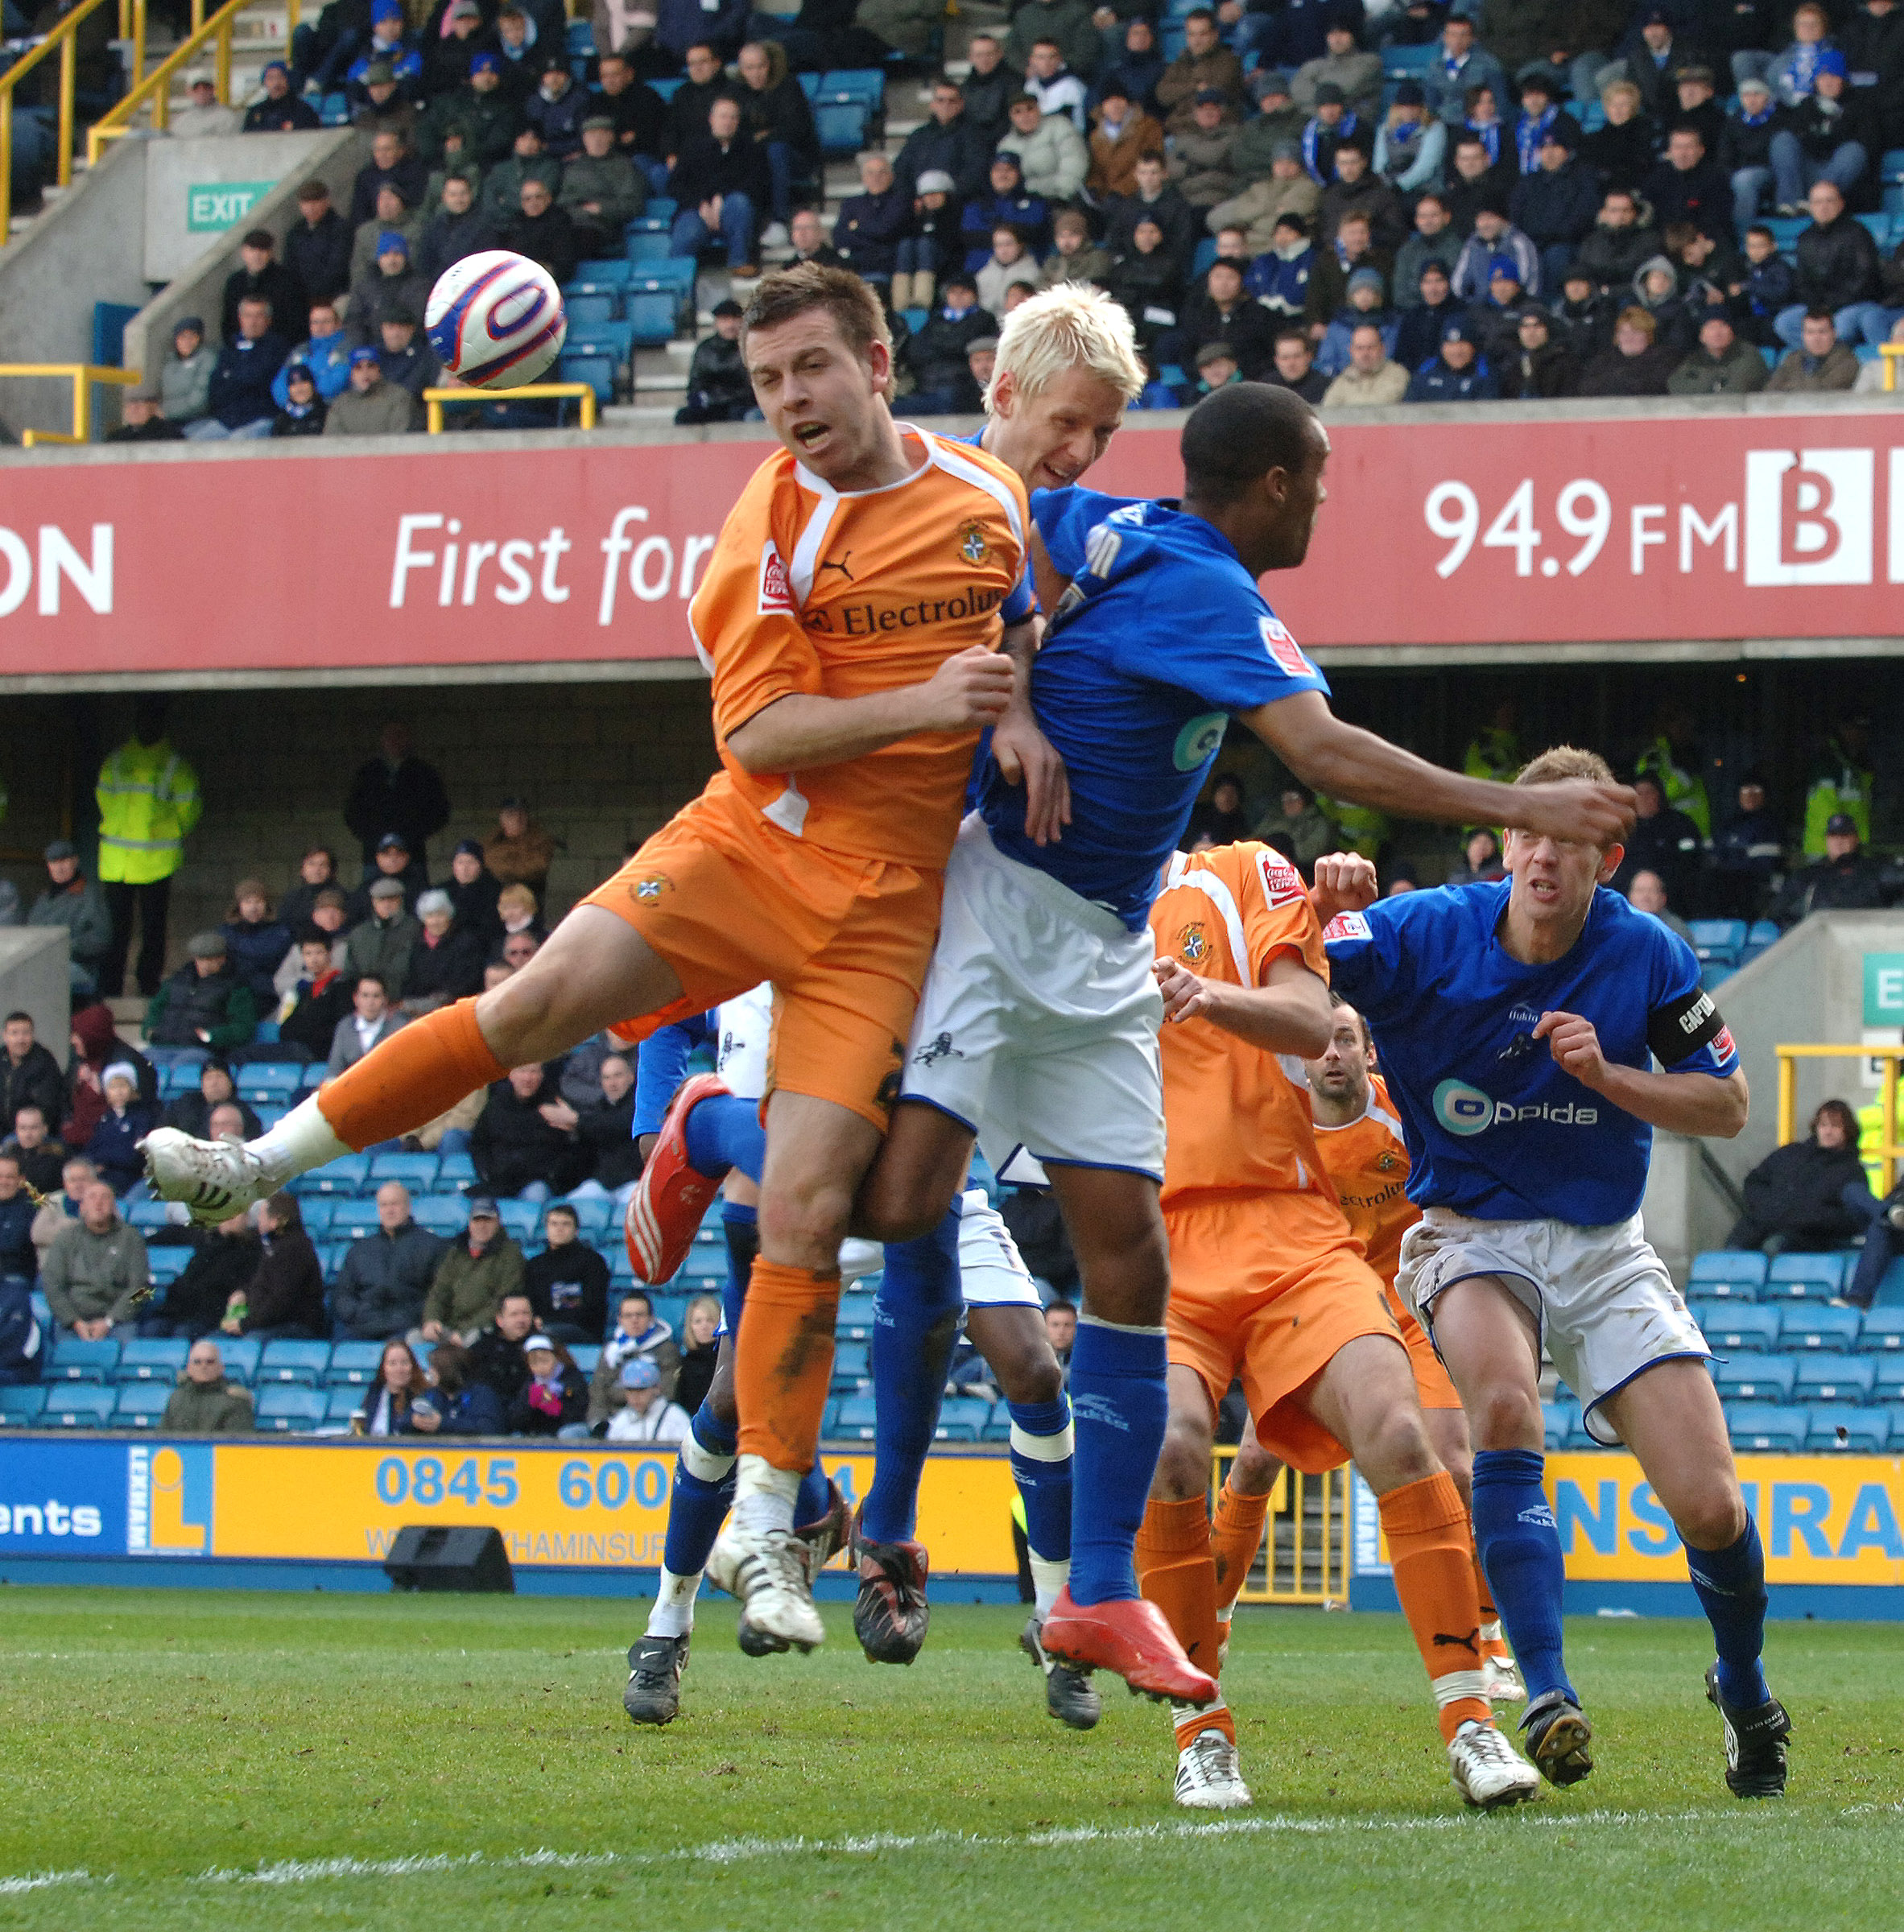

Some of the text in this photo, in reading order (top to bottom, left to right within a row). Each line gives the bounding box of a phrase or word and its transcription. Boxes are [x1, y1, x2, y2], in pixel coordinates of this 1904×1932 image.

[193, 192, 253, 221] EXIT
[390, 505, 716, 626] First for
[1423, 478, 1612, 580] 94.9
[1630, 502, 1739, 576] FM
[375, 1455, 520, 1508] 0845
[559, 1459, 669, 1510] 600
